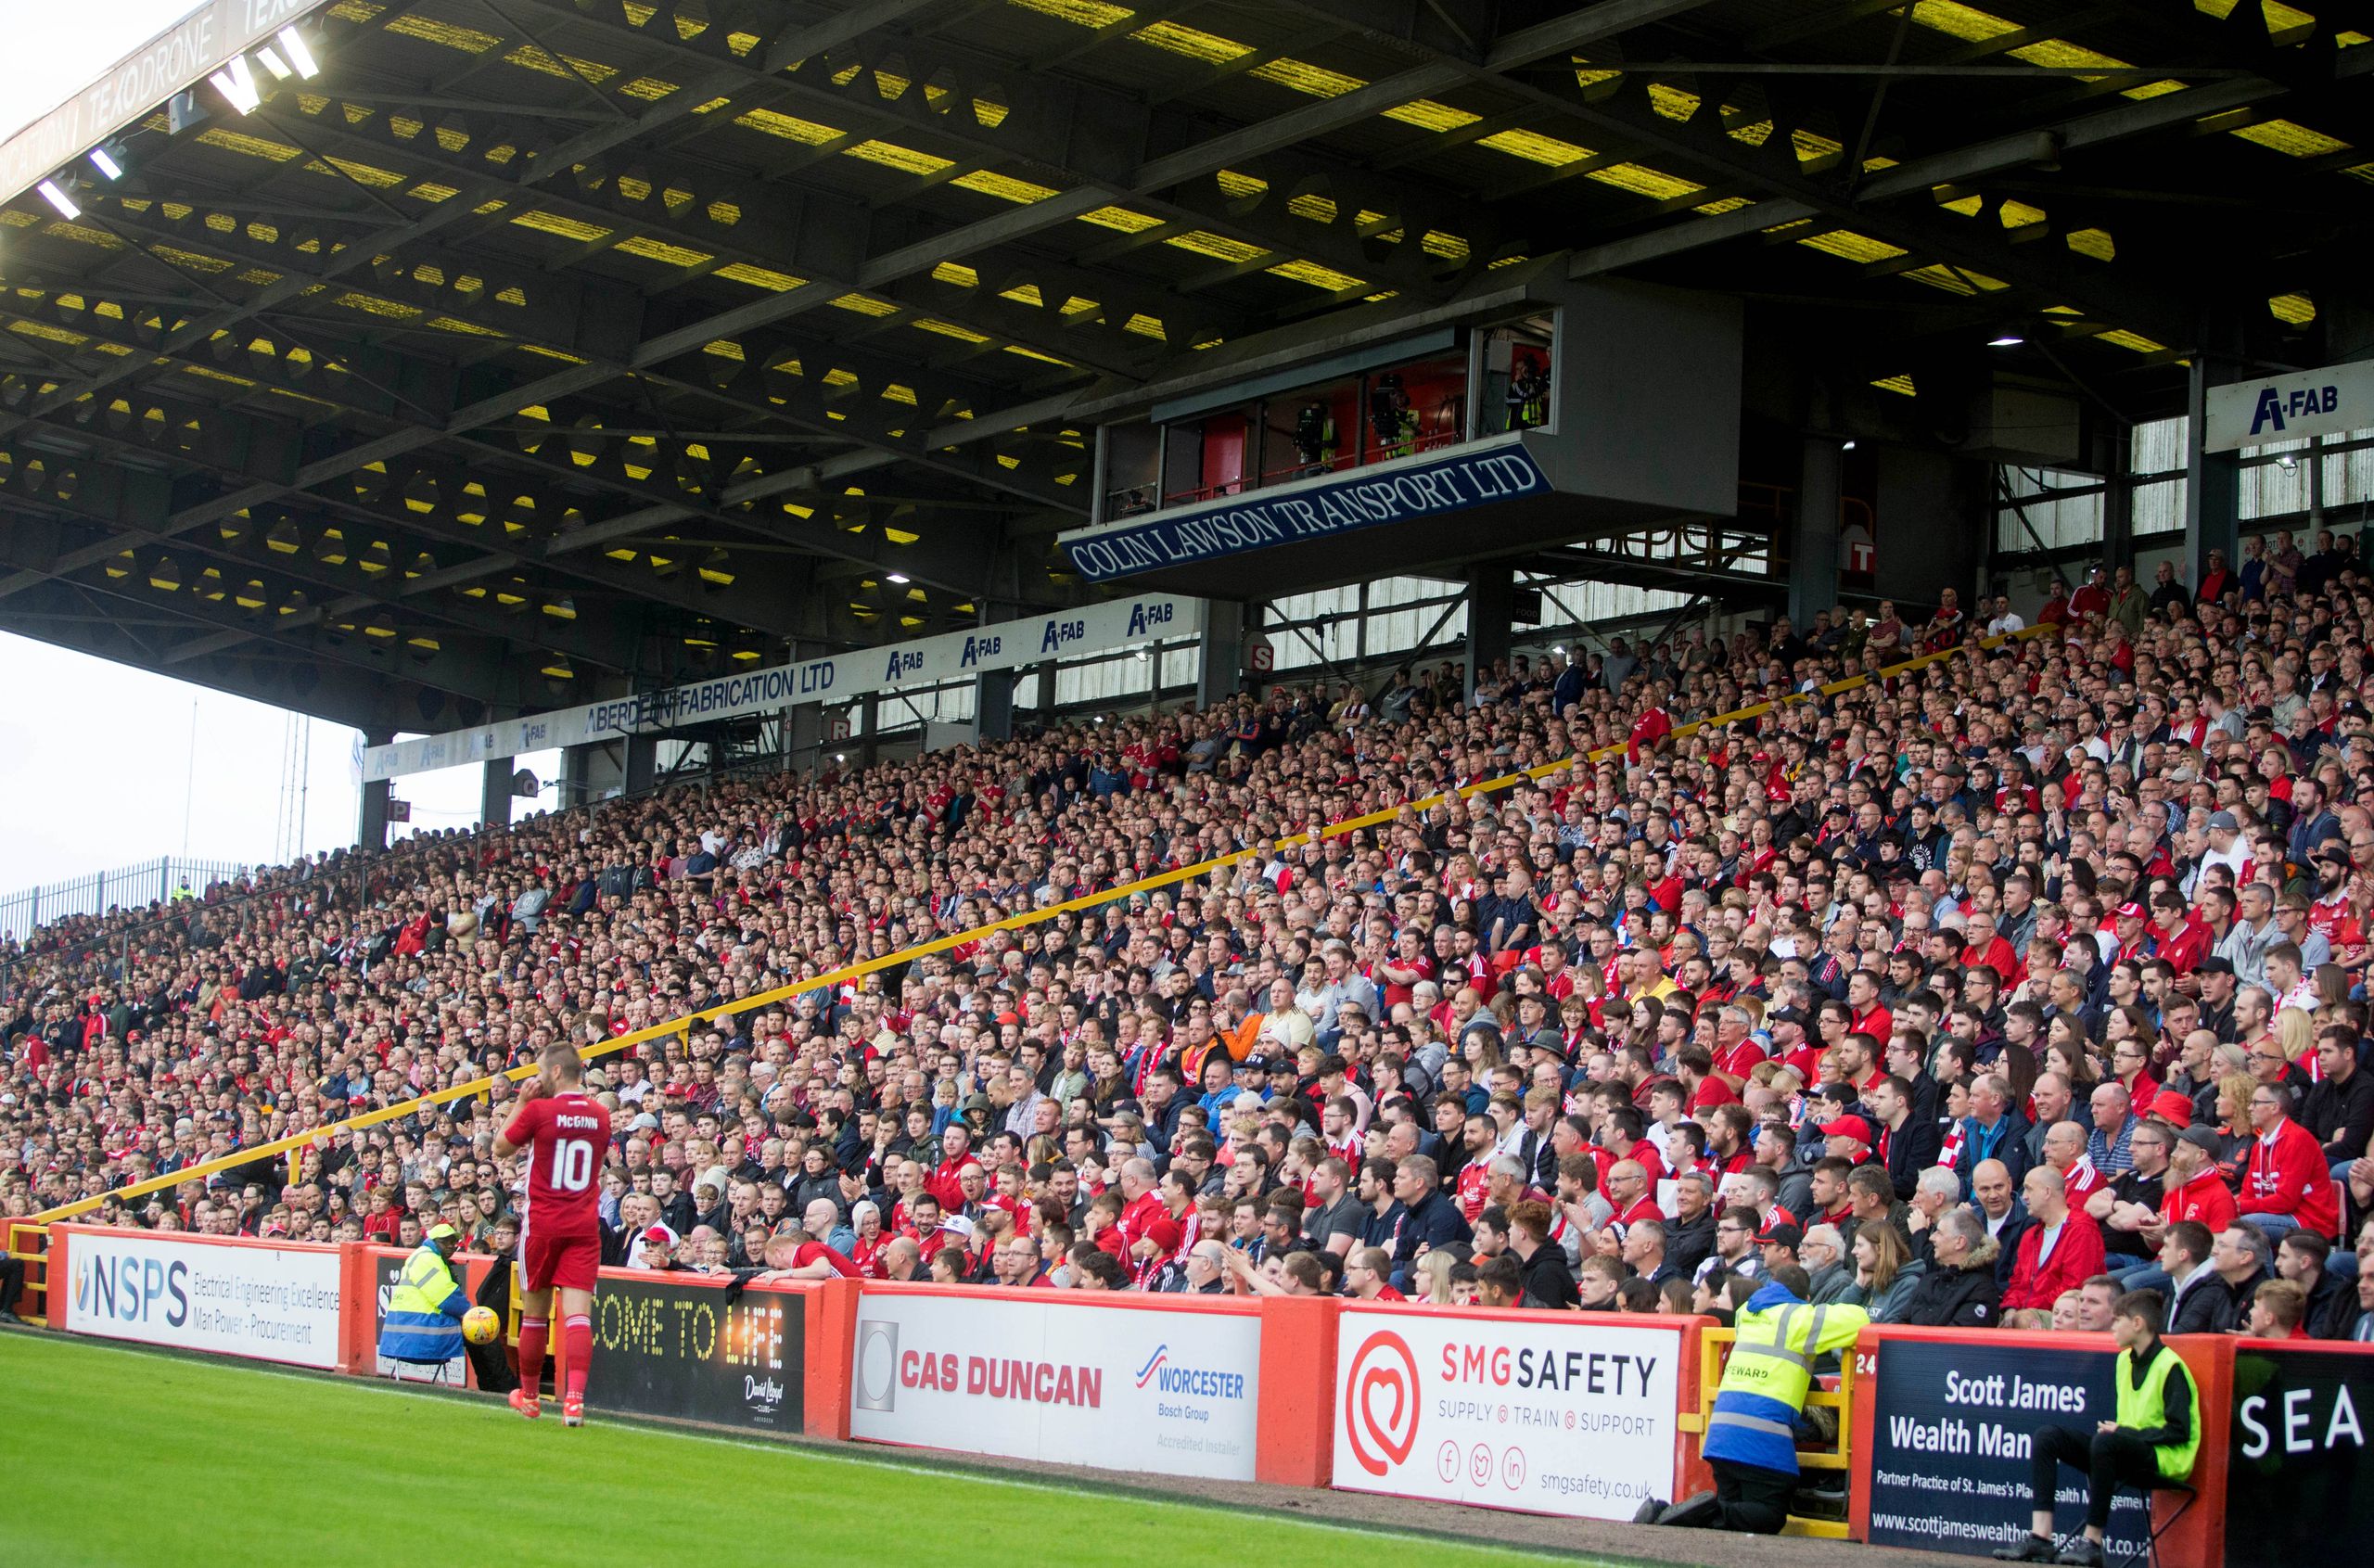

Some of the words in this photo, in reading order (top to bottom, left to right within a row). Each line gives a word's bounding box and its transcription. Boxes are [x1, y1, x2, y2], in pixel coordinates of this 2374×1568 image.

[1071, 535, 1160, 577] COLIN
[1156, 507, 1280, 557] LAWSON
[1276, 470, 1468, 534] TRANSPORT
[1462, 455, 1537, 499] LTD
[1854, 545, 1873, 570] T
[1255, 646, 1271, 669] S
[680, 669, 794, 716] FABRICATION
[801, 661, 835, 692] LTD
[833, 721, 849, 739] R
[524, 779, 537, 794] Q
[394, 802, 405, 817] P
[557, 1115, 598, 1130] McGINN
[551, 1139, 593, 1192] 10
[94, 1254, 188, 1328] NSPS
[195, 1271, 233, 1300] Electrical
[236, 1276, 288, 1311] Engineering
[291, 1281, 340, 1311] Excellence
[193, 1307, 212, 1332] Man
[215, 1309, 242, 1334] Power
[251, 1314, 312, 1345] Procurement
[674, 1300, 716, 1360] TO
[726, 1305, 783, 1370] LIFE
[900, 1350, 959, 1392] CAS
[967, 1356, 1102, 1409] DUNCAN
[1857, 1354, 1875, 1374] 24
[745, 1374, 767, 1401] David
[766, 1376, 784, 1404] Lloyd
[1159, 1367, 1244, 1399] WORCESTER
[1945, 1370, 2004, 1408] Scott
[2009, 1374, 2086, 1413] James
[757, 1404, 771, 1413] CLUBS
[1158, 1403, 1182, 1420] Bosch
[1184, 1406, 1209, 1423] Group
[1439, 1400, 1492, 1424] SUPPLY
[1514, 1407, 1559, 1427] TRAIN
[1581, 1413, 1655, 1436] SUPPORT
[2240, 1383, 2364, 1459] SEA
[1157, 1434, 1203, 1452] Accredited
[1206, 1438, 1241, 1457] Installer
[1890, 1415, 1971, 1454] Wealth
[1541, 1472, 1653, 1499] smgsafety.co.uk
[1877, 1470, 1910, 1486] Partner
[1912, 1472, 1948, 1491] Practice
[1950, 1476, 1961, 1492] of
[1962, 1478, 1975, 1494] St.
[1976, 1480, 2013, 1498] James's
[2054, 1486, 2080, 1504] ealth
